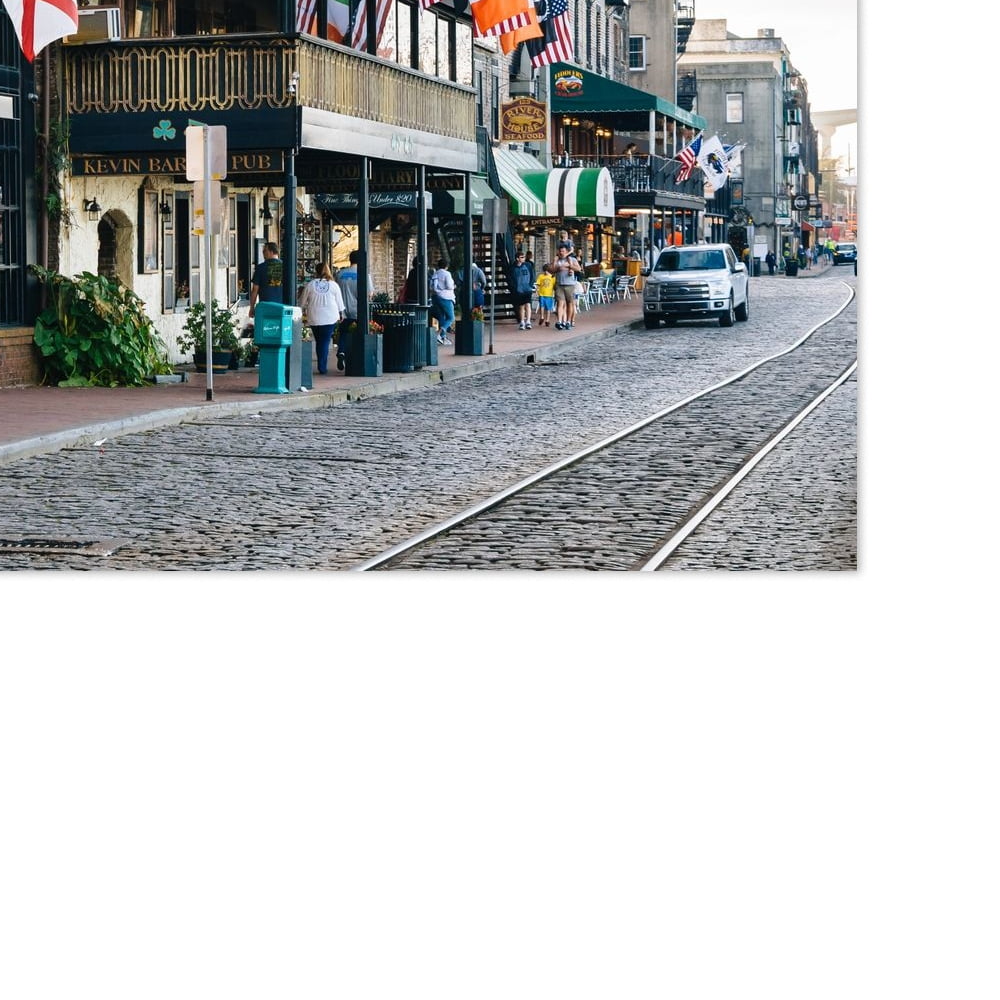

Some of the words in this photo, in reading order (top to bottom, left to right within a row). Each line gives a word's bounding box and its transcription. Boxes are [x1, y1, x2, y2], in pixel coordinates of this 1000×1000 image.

[507, 106, 541, 118] RIVER
[507, 122, 541, 132] HOUSE
[505, 132, 545, 140] SEAFOOD
[84, 157, 141, 174] KEVIN
[150, 157, 187, 173] BAR
[231, 154, 272, 170] PUB
[341, 193, 360, 207] Thing
[369, 193, 393, 203] Under
[396, 193, 413, 203] $20
[531, 218, 561, 226] ENTRANCE
